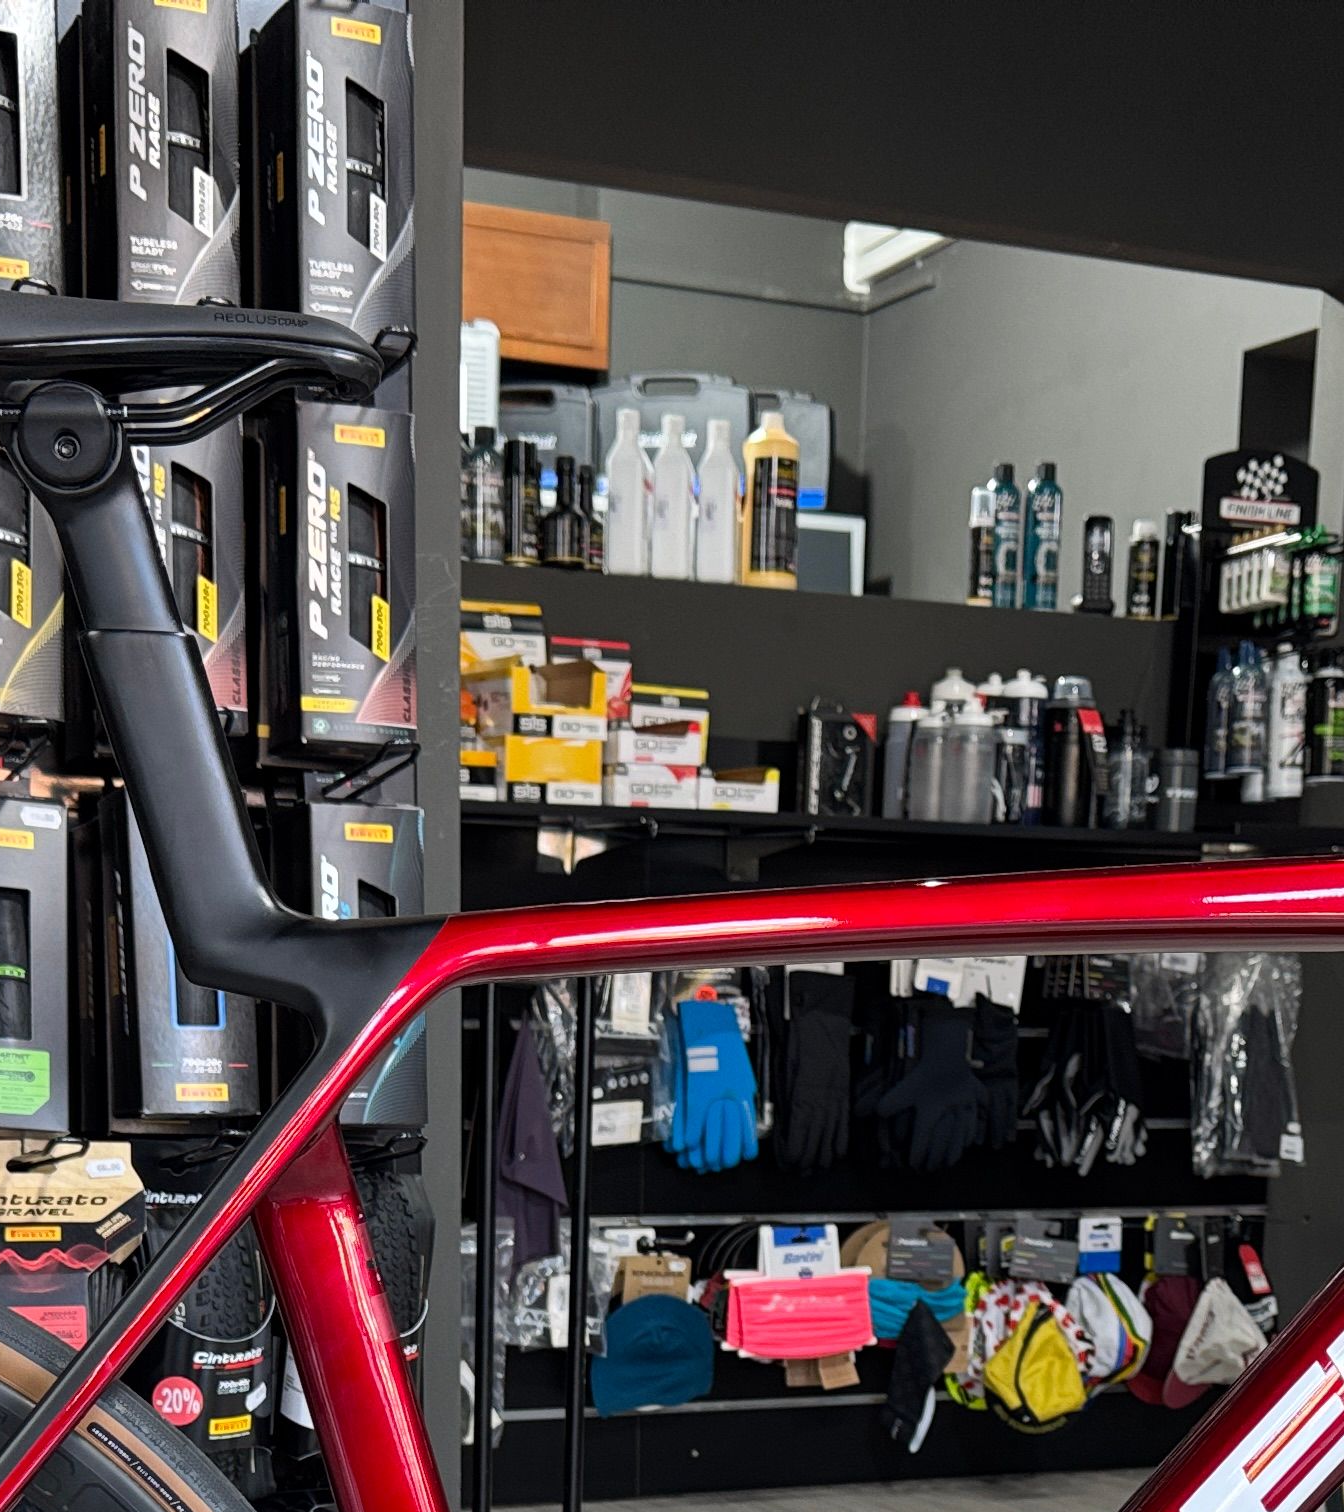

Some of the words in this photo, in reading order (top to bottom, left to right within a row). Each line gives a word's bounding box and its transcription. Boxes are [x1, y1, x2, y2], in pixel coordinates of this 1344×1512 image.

[336, 22, 377, 39] PIRELLI
[128, 28, 146, 161] ZERO
[148, 92, 160, 169] RACE
[307, 57, 324, 187] ZERO
[326, 121, 338, 195] RACE
[130, 163, 147, 201] P
[308, 189, 325, 225] P
[130, 236, 178, 251] TUBELESS
[131, 246, 164, 257] READY
[309, 260, 354, 274] TUBELESS
[310, 269, 341, 280] READY
[214, 311, 277, 326] AEOLUS
[339, 428, 380, 444] PIRELLI
[153, 463, 166, 499] RS
[329, 487, 342, 522] RS
[308, 458, 326, 597] ZERO
[330, 548, 342, 616] RACE
[309, 603, 328, 640] P
[348, 826, 390, 841] PIRELLI
[181, 1087, 223, 1097] PIRELLI
[9, 1229, 57, 1239] PIRELLI
[193, 1348, 263, 1366] Cinturato
[155, 1386, 203, 1415] -20%
[213, 1418, 249, 1432] PIRELLI
